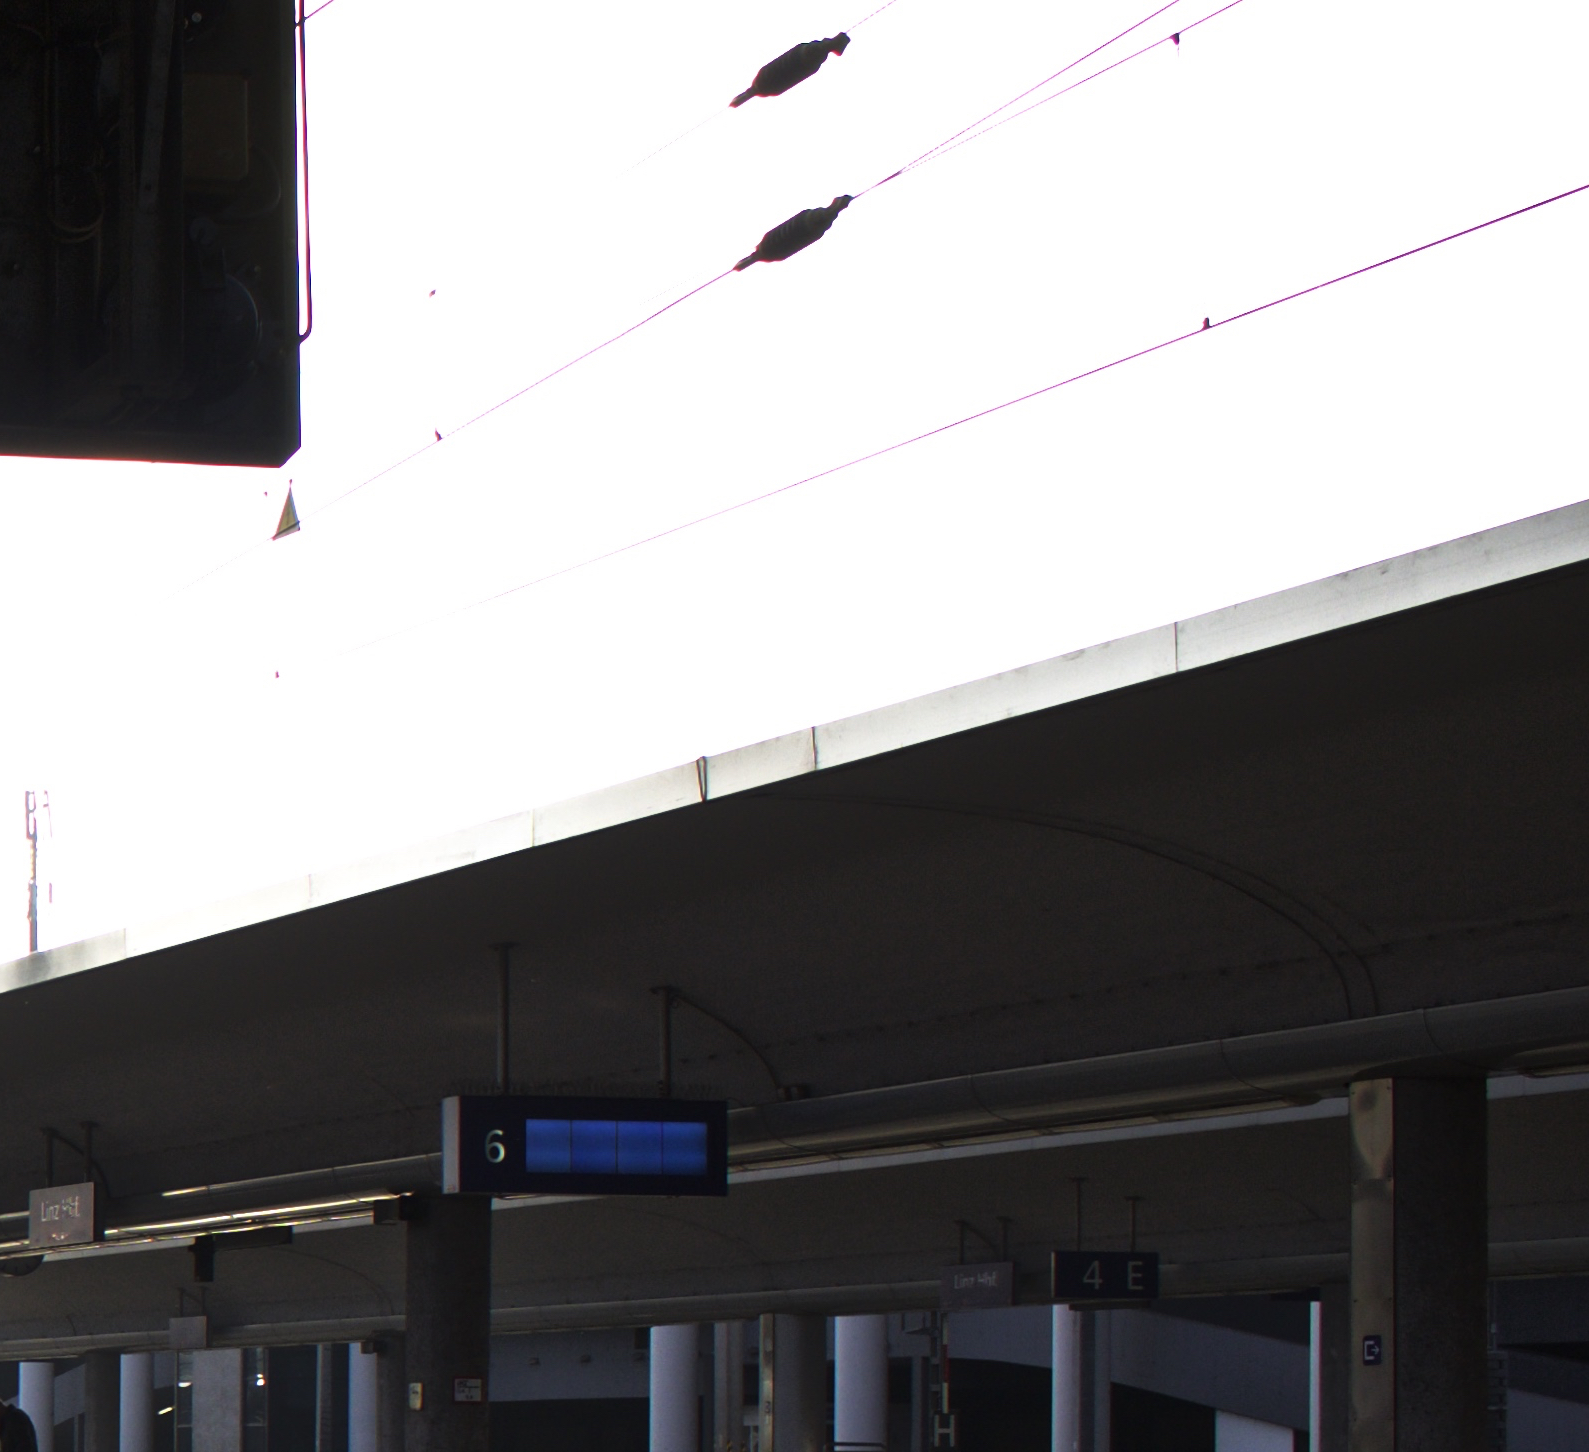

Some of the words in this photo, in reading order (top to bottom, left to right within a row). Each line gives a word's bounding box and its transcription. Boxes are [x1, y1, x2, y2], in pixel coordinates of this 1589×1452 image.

[484, 1129, 506, 1164] 6
[1082, 1259, 1103, 1291] 4
[1127, 1260, 1144, 1291] E
[933, 1414, 955, 1448] H
